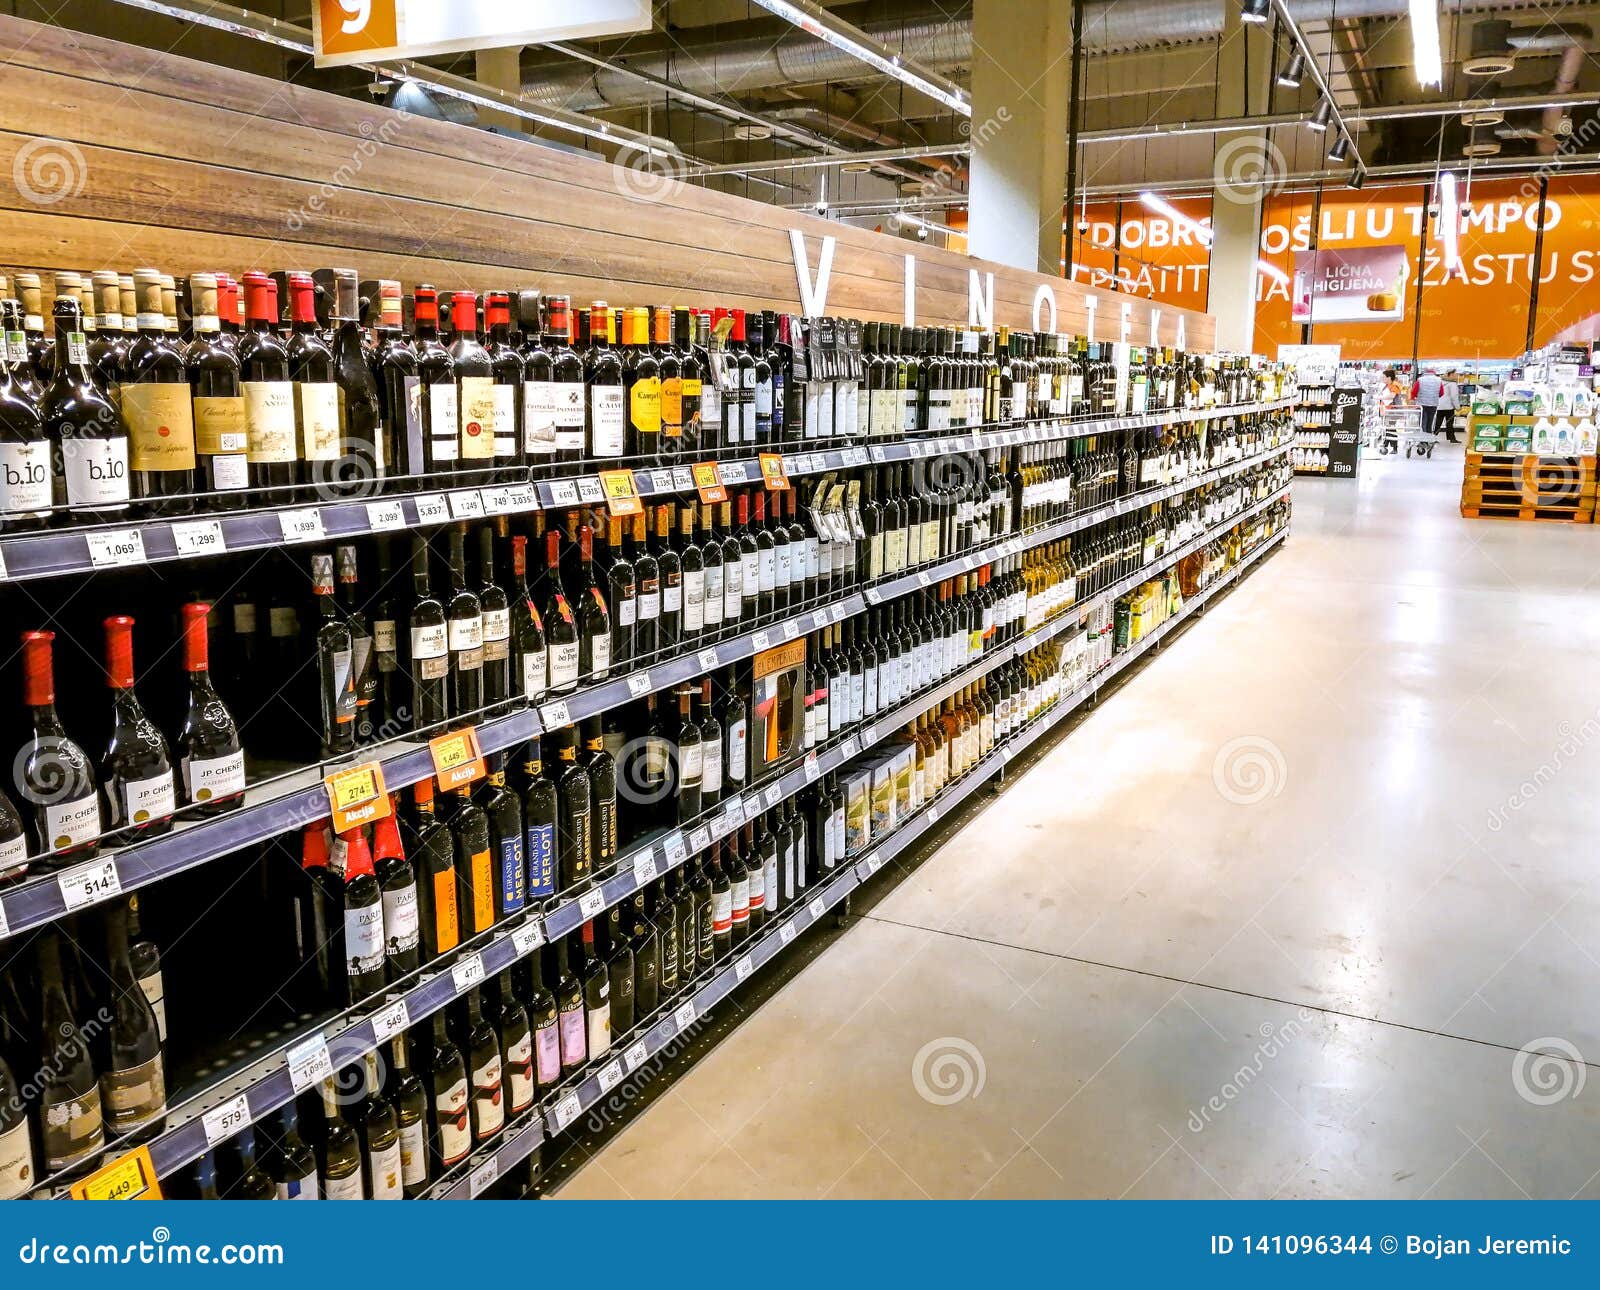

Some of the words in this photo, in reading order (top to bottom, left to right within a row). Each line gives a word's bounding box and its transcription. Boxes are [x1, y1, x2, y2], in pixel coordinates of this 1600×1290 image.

[1366, 207, 1394, 239] U
[1403, 199, 1562, 241] TMPO
[1326, 263, 1372, 278] LIČNA
[1314, 278, 1384, 292] HIGIJENA
[294, 521, 315, 533] 1,899
[189, 534, 216, 548] 1,299
[105, 543, 135, 557] 1,069
[215, 763, 242, 775] CHENET
[452, 767, 476, 783] Akcija
[349, 785, 366, 800] 274
[345, 804, 376, 823] Akcija
[541, 831, 552, 887] MERLOT
[513, 843, 524, 900] MERLOT
[84, 876, 109, 896] 514
[524, 932, 537, 946] 509
[464, 966, 478, 980] 477
[386, 1014, 402, 1029] 549
[303, 1060, 324, 1078] 1,099
[221, 1110, 241, 1129] 579
[108, 1181, 130, 1200] 449
